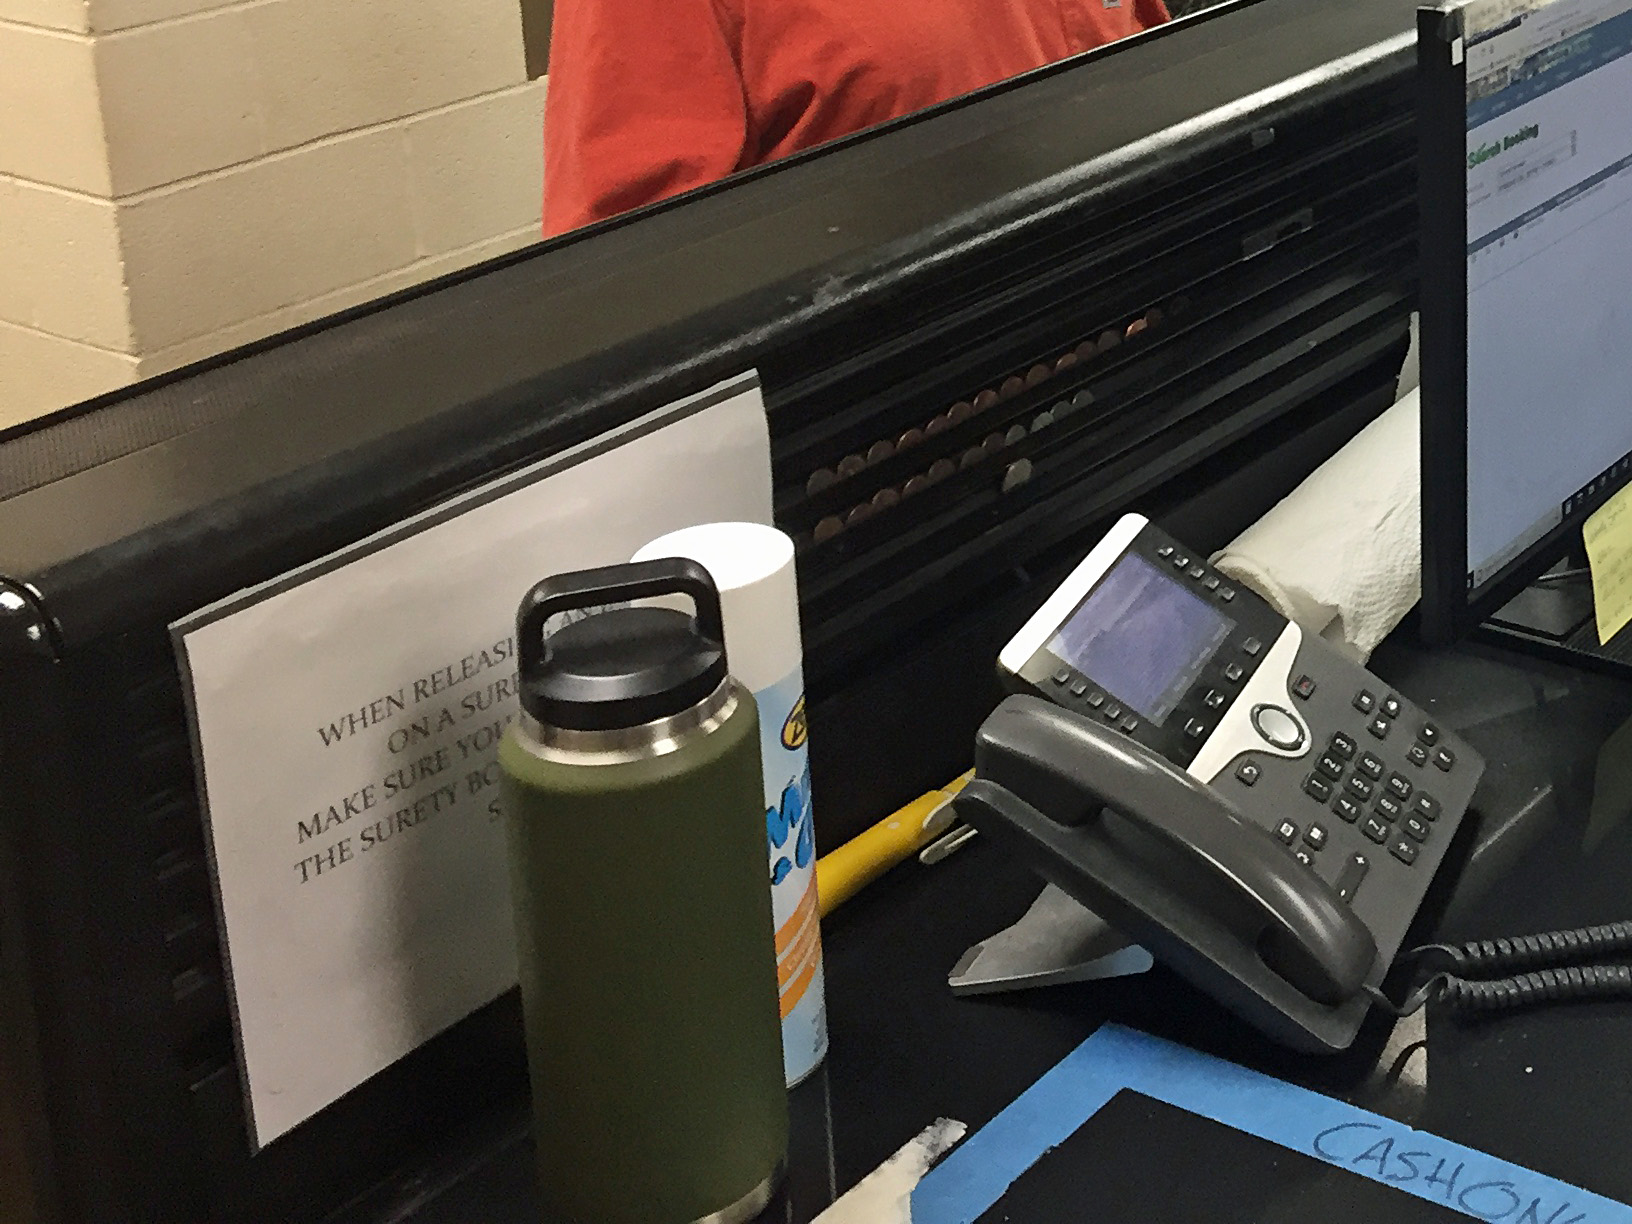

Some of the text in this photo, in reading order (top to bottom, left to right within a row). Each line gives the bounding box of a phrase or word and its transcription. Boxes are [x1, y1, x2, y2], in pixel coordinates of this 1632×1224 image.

[316, 689, 406, 747] WHEN
[412, 637, 515, 704] RELEASI
[387, 672, 520, 754] ON A SURE
[294, 837, 355, 885] THE
[360, 781, 458, 853] SURETY
[465, 761, 501, 795] BO
[297, 784, 377, 844] MAKE
[382, 746, 449, 800] SURE
[1312, 1122, 1465, 1200] CASH
